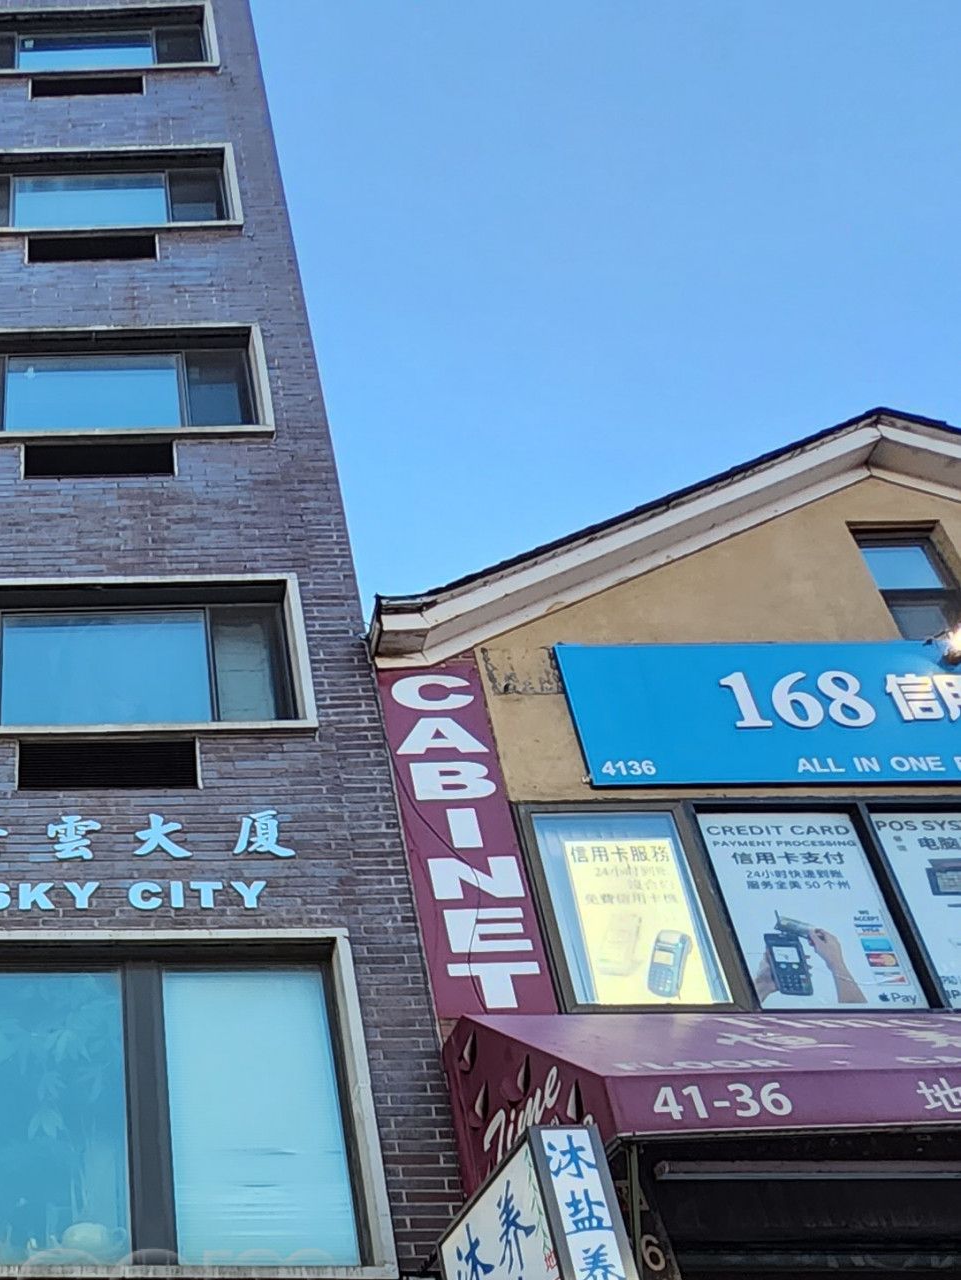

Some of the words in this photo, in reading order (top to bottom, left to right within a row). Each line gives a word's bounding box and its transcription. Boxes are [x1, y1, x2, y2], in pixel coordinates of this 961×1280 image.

[719, 671, 877, 730] 168
[601, 760, 657, 777] 4136
[797, 757, 846, 774] ALL
[854, 757, 882, 773] IN
[890, 756, 947, 773] ONE
[706, 825, 783, 836] CREDIT
[790, 825, 850, 836] CARD
[876, 820, 919, 832] POS
[391, 675, 540, 1009] CABINET
[731, 851, 846, 865] 信用卡支付
[128, 880, 268, 910] CITY
[890, 992, 917, 1005] Pay
[653, 1080, 793, 1121] 41-36
